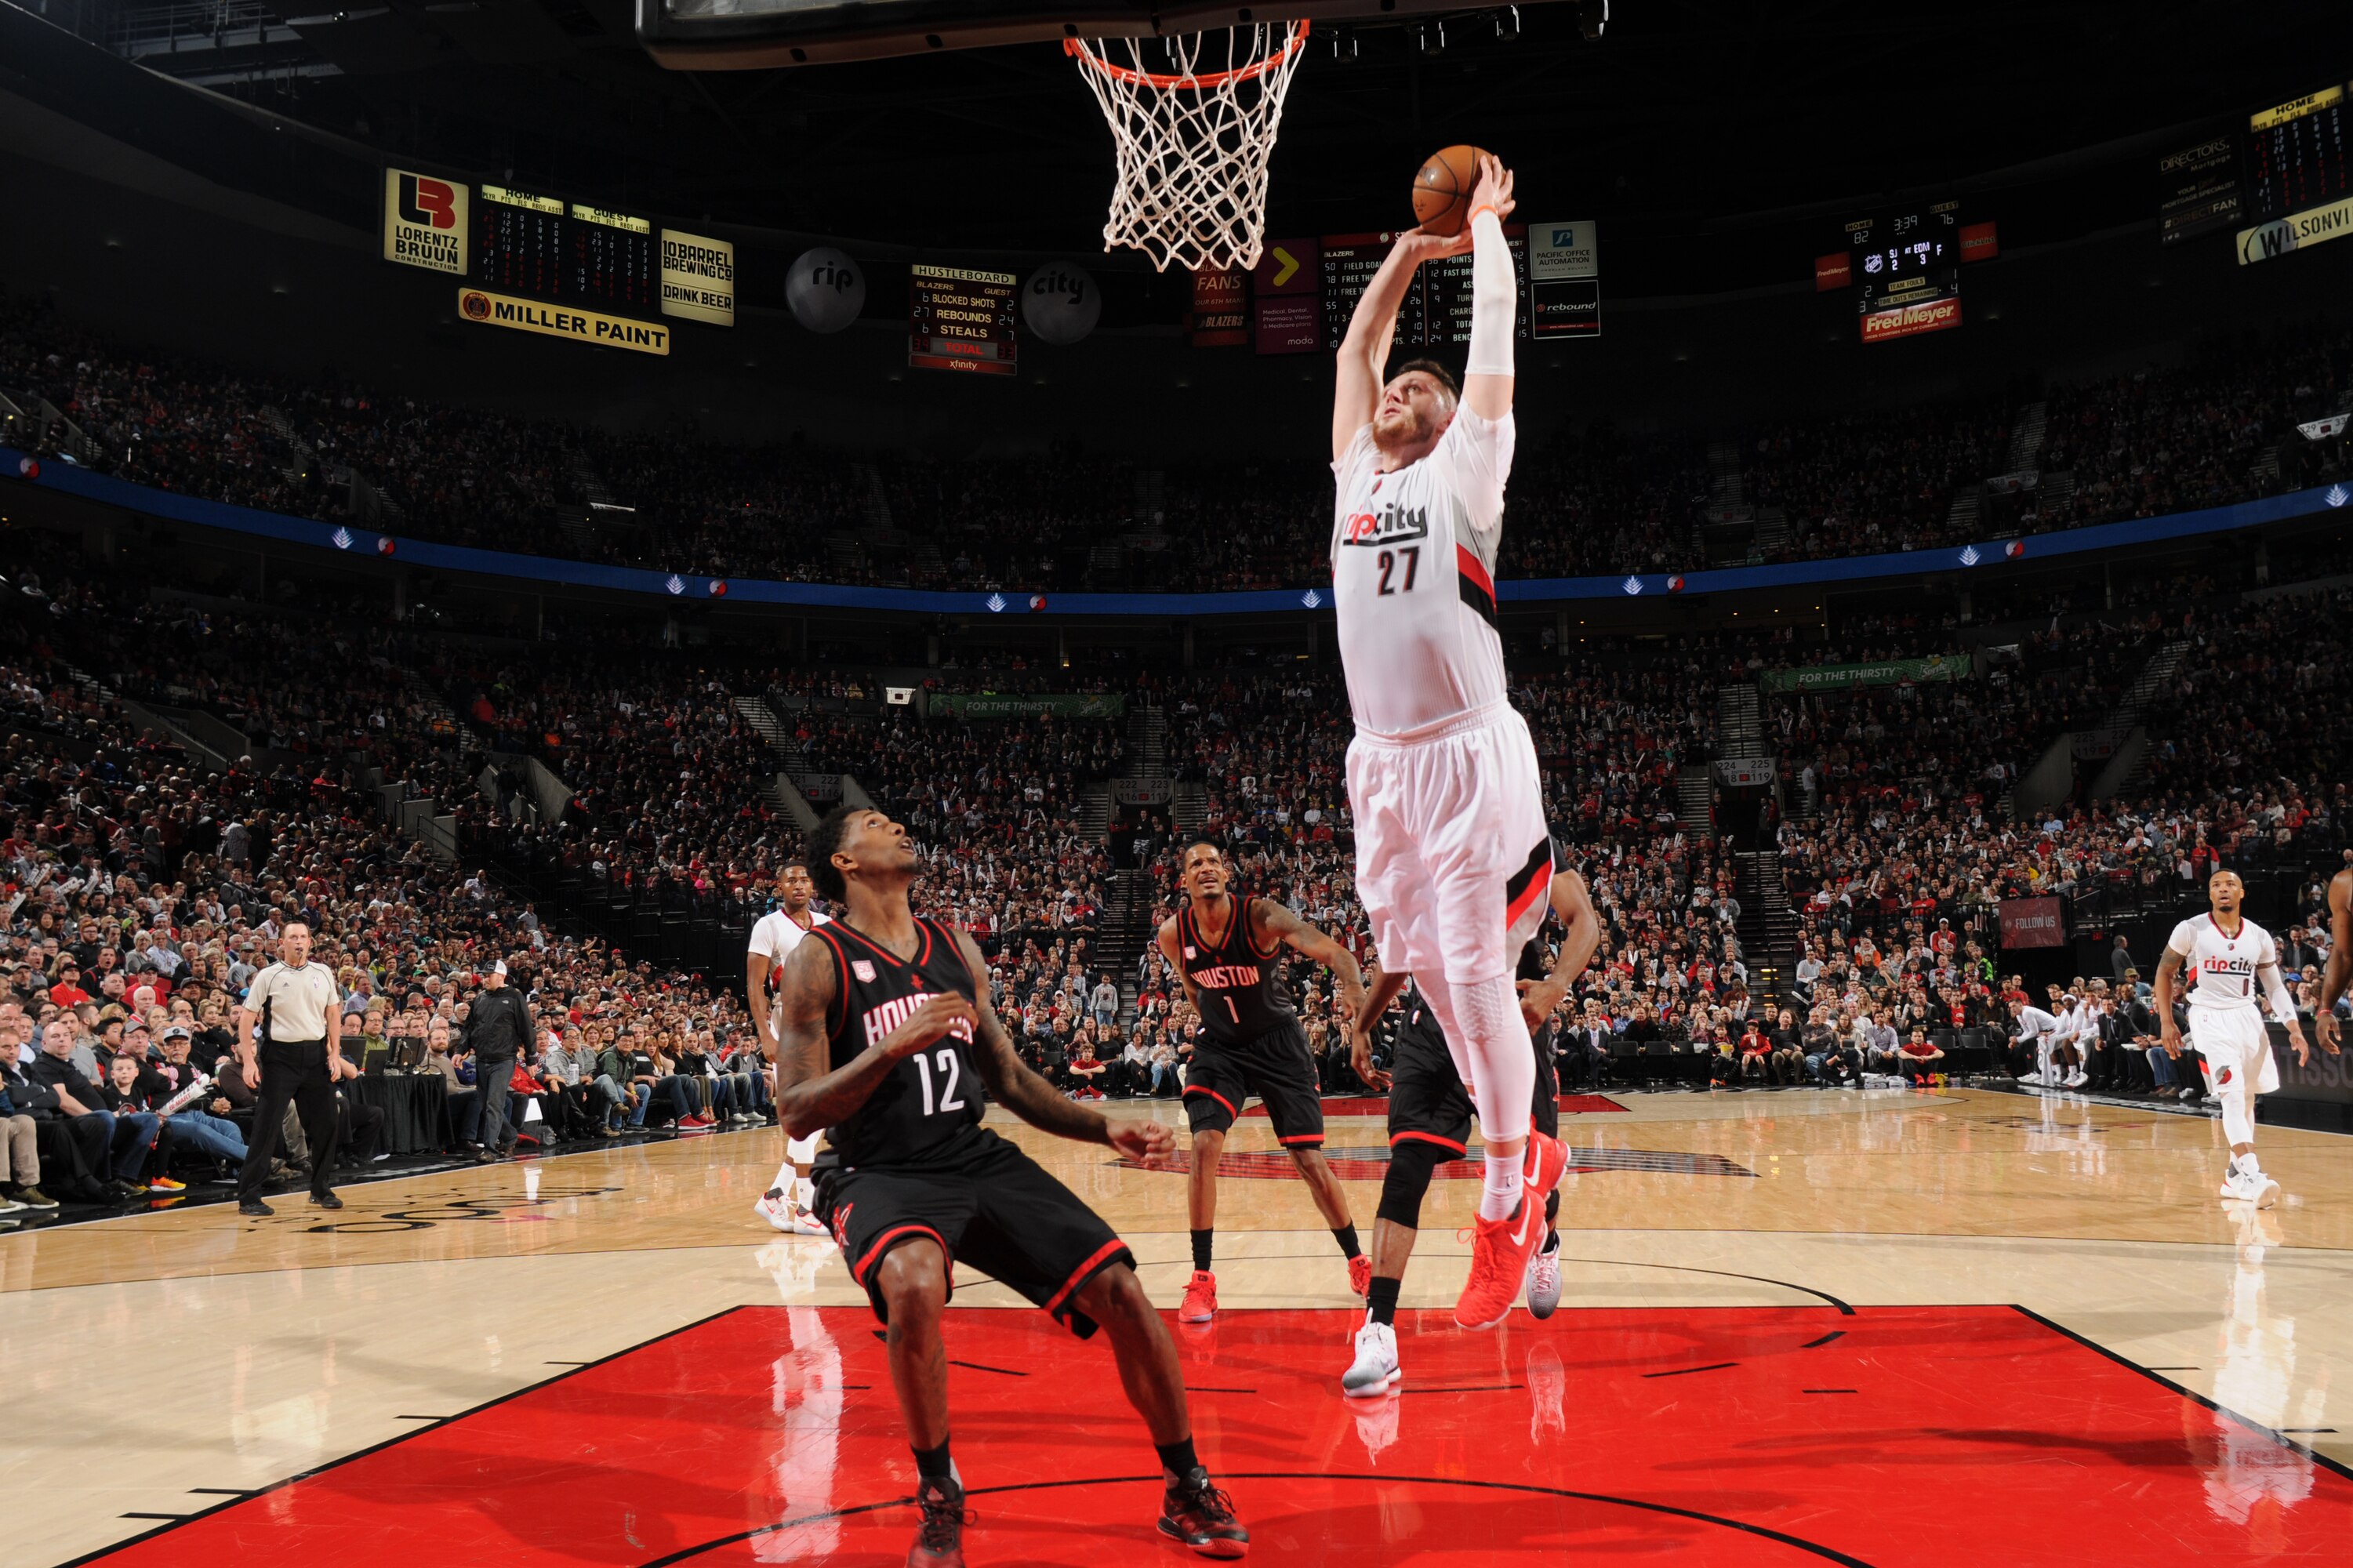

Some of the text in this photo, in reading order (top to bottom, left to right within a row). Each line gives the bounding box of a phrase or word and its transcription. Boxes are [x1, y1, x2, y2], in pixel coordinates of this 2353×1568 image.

[2276, 95, 2315, 115] HOME
[506, 188, 540, 203] HOME
[547, 206, 562, 215] ASST
[594, 208, 630, 222] GUEST
[1846, 201, 1959, 230] HOME GUEST
[396, 225, 458, 249] LORENTZ
[635, 225, 648, 234] ASST
[1854, 230, 1869, 244] 82
[1894, 215, 1918, 231] 3:39
[396, 239, 457, 264] BRUUN
[663, 240, 732, 268] 10 BARREL
[1447, 251, 1523, 264] POINTS 42
[1889, 249, 1897, 259] SJ
[1913, 241, 1930, 254] EDM
[1936, 244, 1942, 256] F
[395, 254, 458, 270] CONSTRUCTION
[663, 256, 716, 278] BREWING
[1344, 262, 1364, 270] FIELD
[1538, 256, 1589, 266] AUTOMATION
[1892, 260, 1898, 270] 2
[1919, 253, 1926, 266] 3
[813, 261, 852, 295] rip
[919, 267, 1009, 283] HUSTLEBOARD
[1431, 269, 1439, 278] 12
[1443, 268, 1460, 277] FAST
[916, 281, 1012, 296] BLAZERS GUEST
[1033, 270, 1084, 304] city
[1196, 275, 1241, 291] FANS
[1865, 278, 1924, 298] 2 TEAM FOULS
[663, 285, 731, 310] DRINK BEER
[932, 294, 968, 306] BLOCKED
[971, 297, 995, 309] SHOTS
[1007, 299, 1014, 311] 2
[1859, 300, 1866, 313] 3
[1908, 289, 1937, 299] REMAINING
[1951, 283, 1958, 294] 4
[1546, 301, 1596, 311] rebound
[913, 306, 1014, 325] 27 REBOUNDS 24
[1205, 315, 1244, 328] BLAZERS
[495, 302, 666, 347] MILLER PAINT
[940, 325, 988, 338] STEALS
[1008, 330, 1014, 341] 7
[1287, 335, 1313, 346] moda
[944, 342, 985, 355] TOTAL
[1330, 339, 1338, 348] 10
[950, 360, 978, 370] xfinity
[1378, 545, 1420, 597] 27
[1799, 673, 1822, 684] FOR
[1823, 670, 1849, 681] THE
[1850, 667, 1897, 680] THIRSTY
[966, 702, 989, 711] FOR
[991, 702, 1012, 711] THE
[1013, 702, 1057, 711] THIRSTY
[1718, 760, 1769, 771] 224 225
[822, 776, 839, 785] 222
[1119, 780, 1168, 789] 222 223
[1751, 772, 1770, 781] 119
[2015, 916, 2055, 929] FOLLOW US
[1190, 965, 1259, 989] HOUSTON
[1223, 996, 1240, 1023] 1
[913, 1048, 965, 1116] 12
